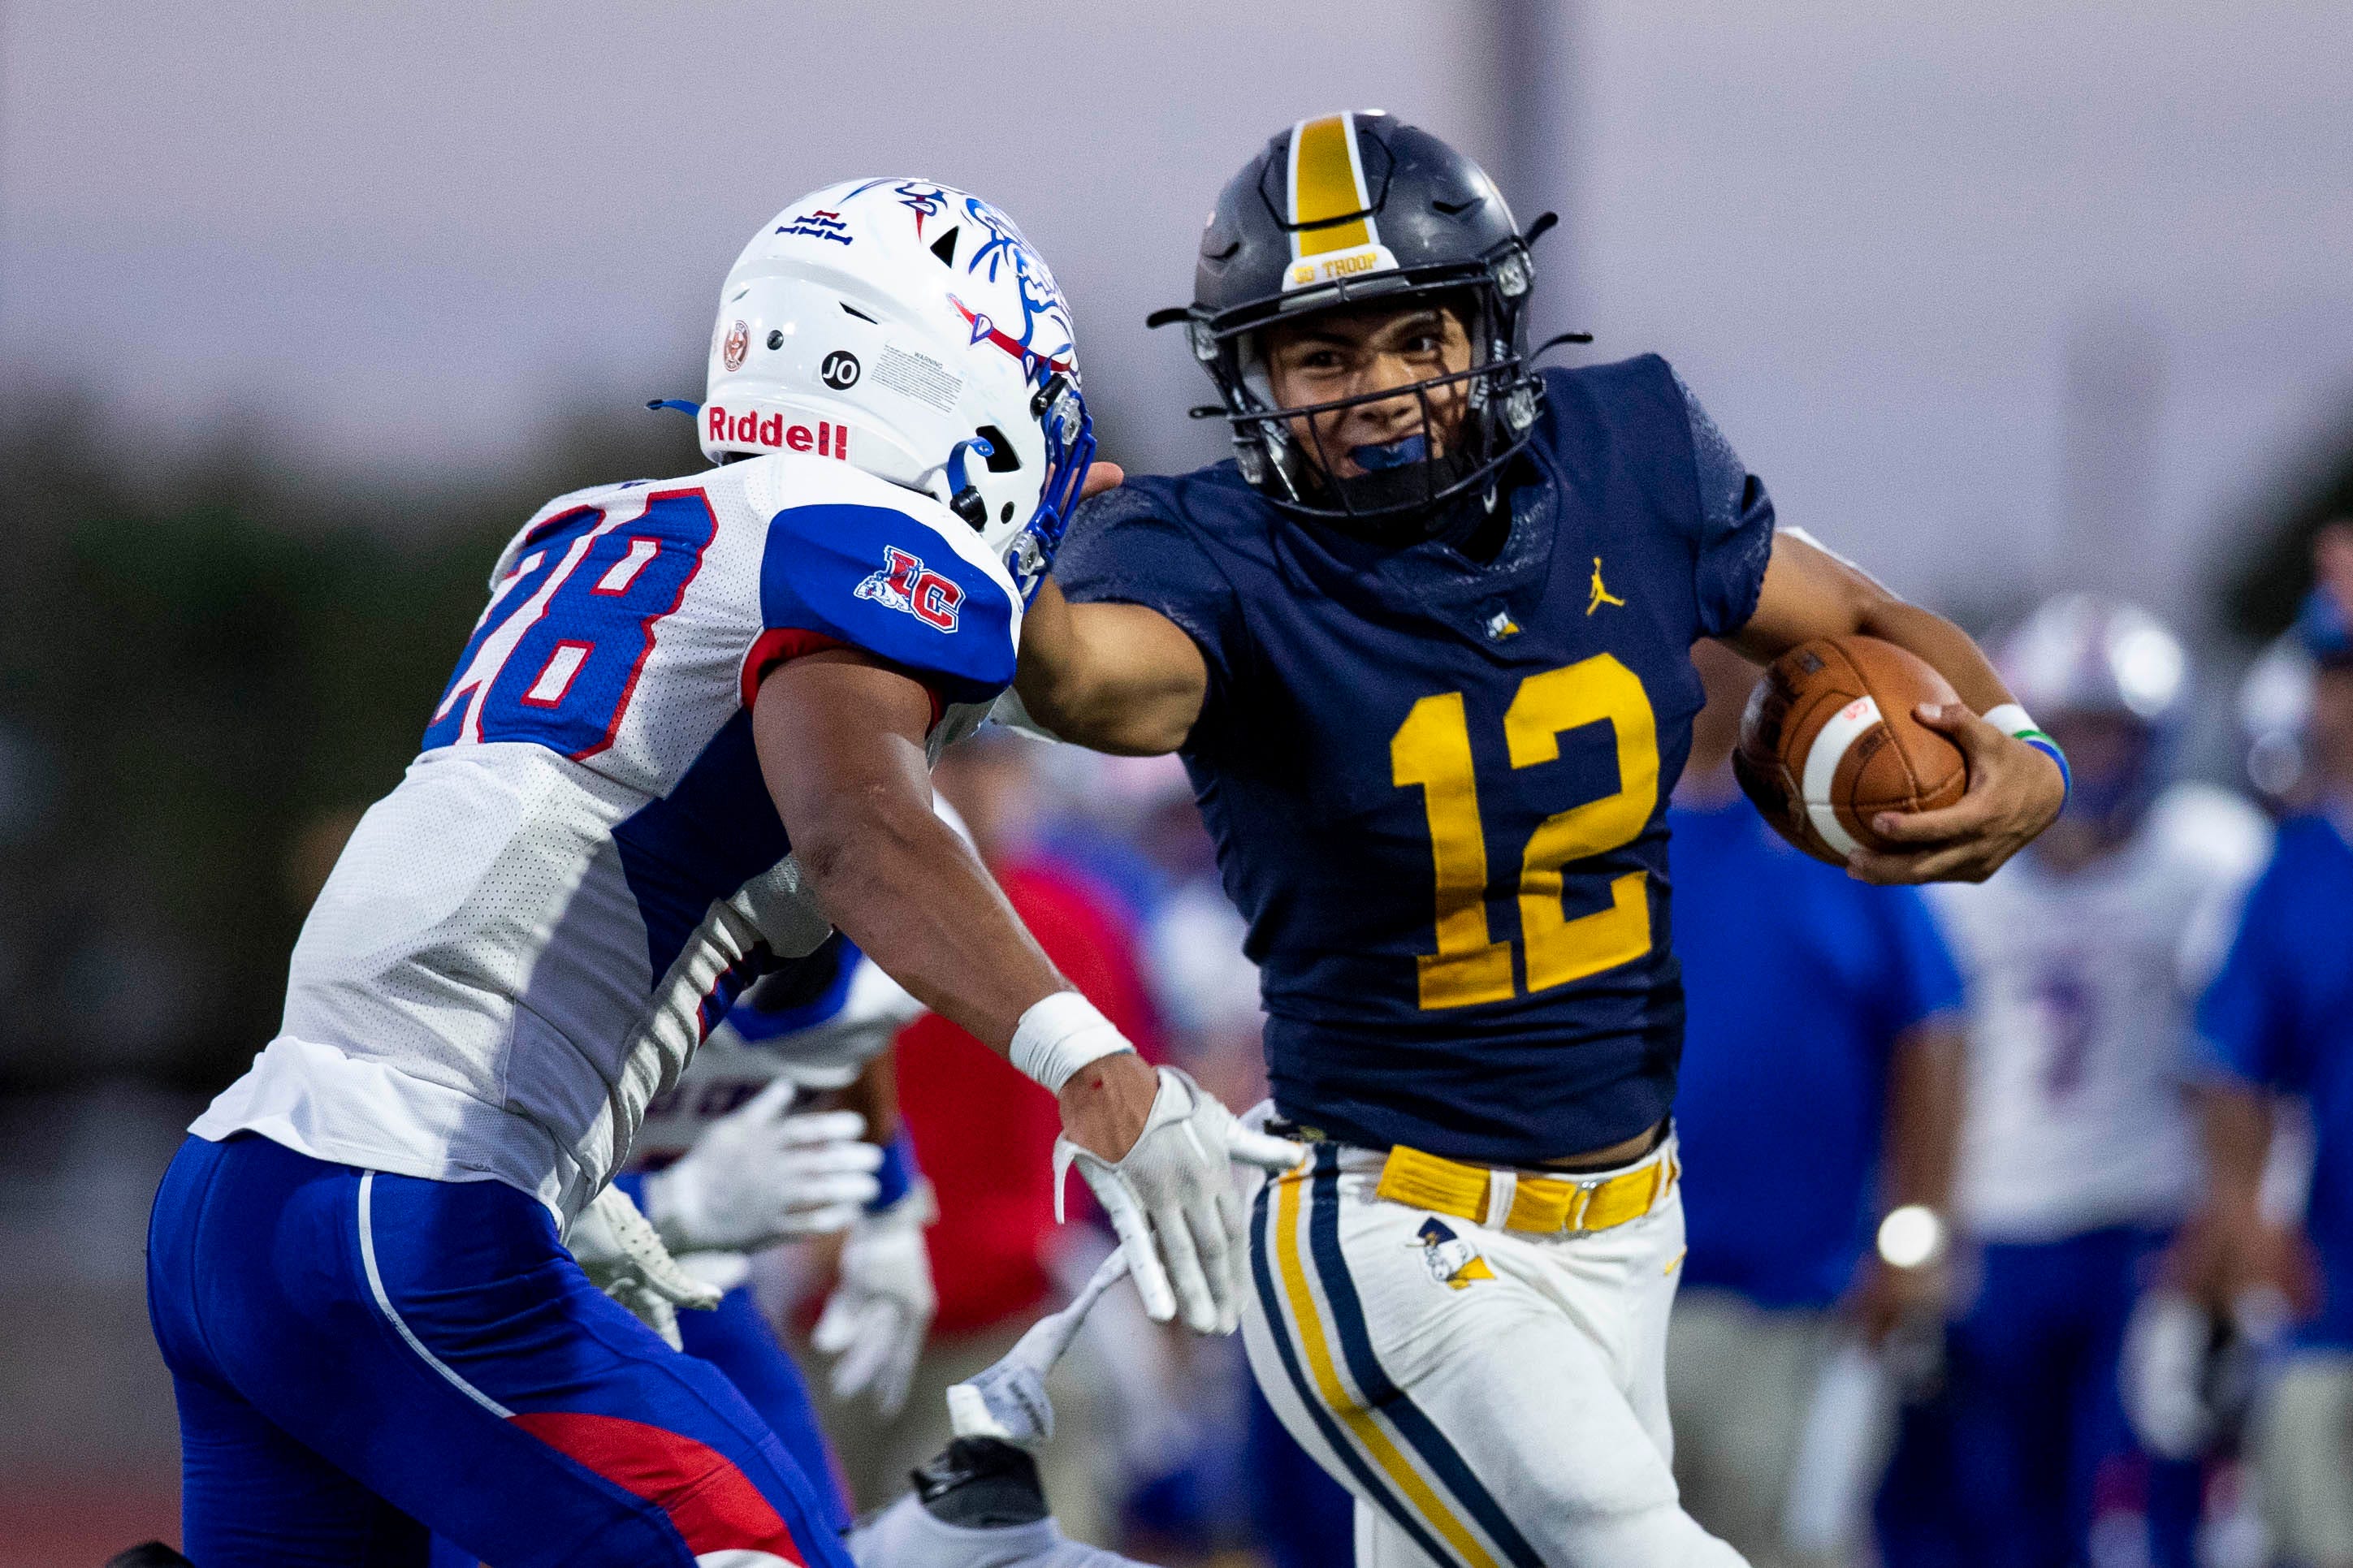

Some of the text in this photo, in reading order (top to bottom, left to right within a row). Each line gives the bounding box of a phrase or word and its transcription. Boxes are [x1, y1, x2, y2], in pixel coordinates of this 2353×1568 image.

[1321, 252, 1378, 278] TROOP
[822, 356, 858, 384] JO
[914, 351, 943, 369] WARNING
[709, 406, 848, 460] Riddell
[422, 486, 719, 762] 28
[1390, 651, 1660, 1010] 12
